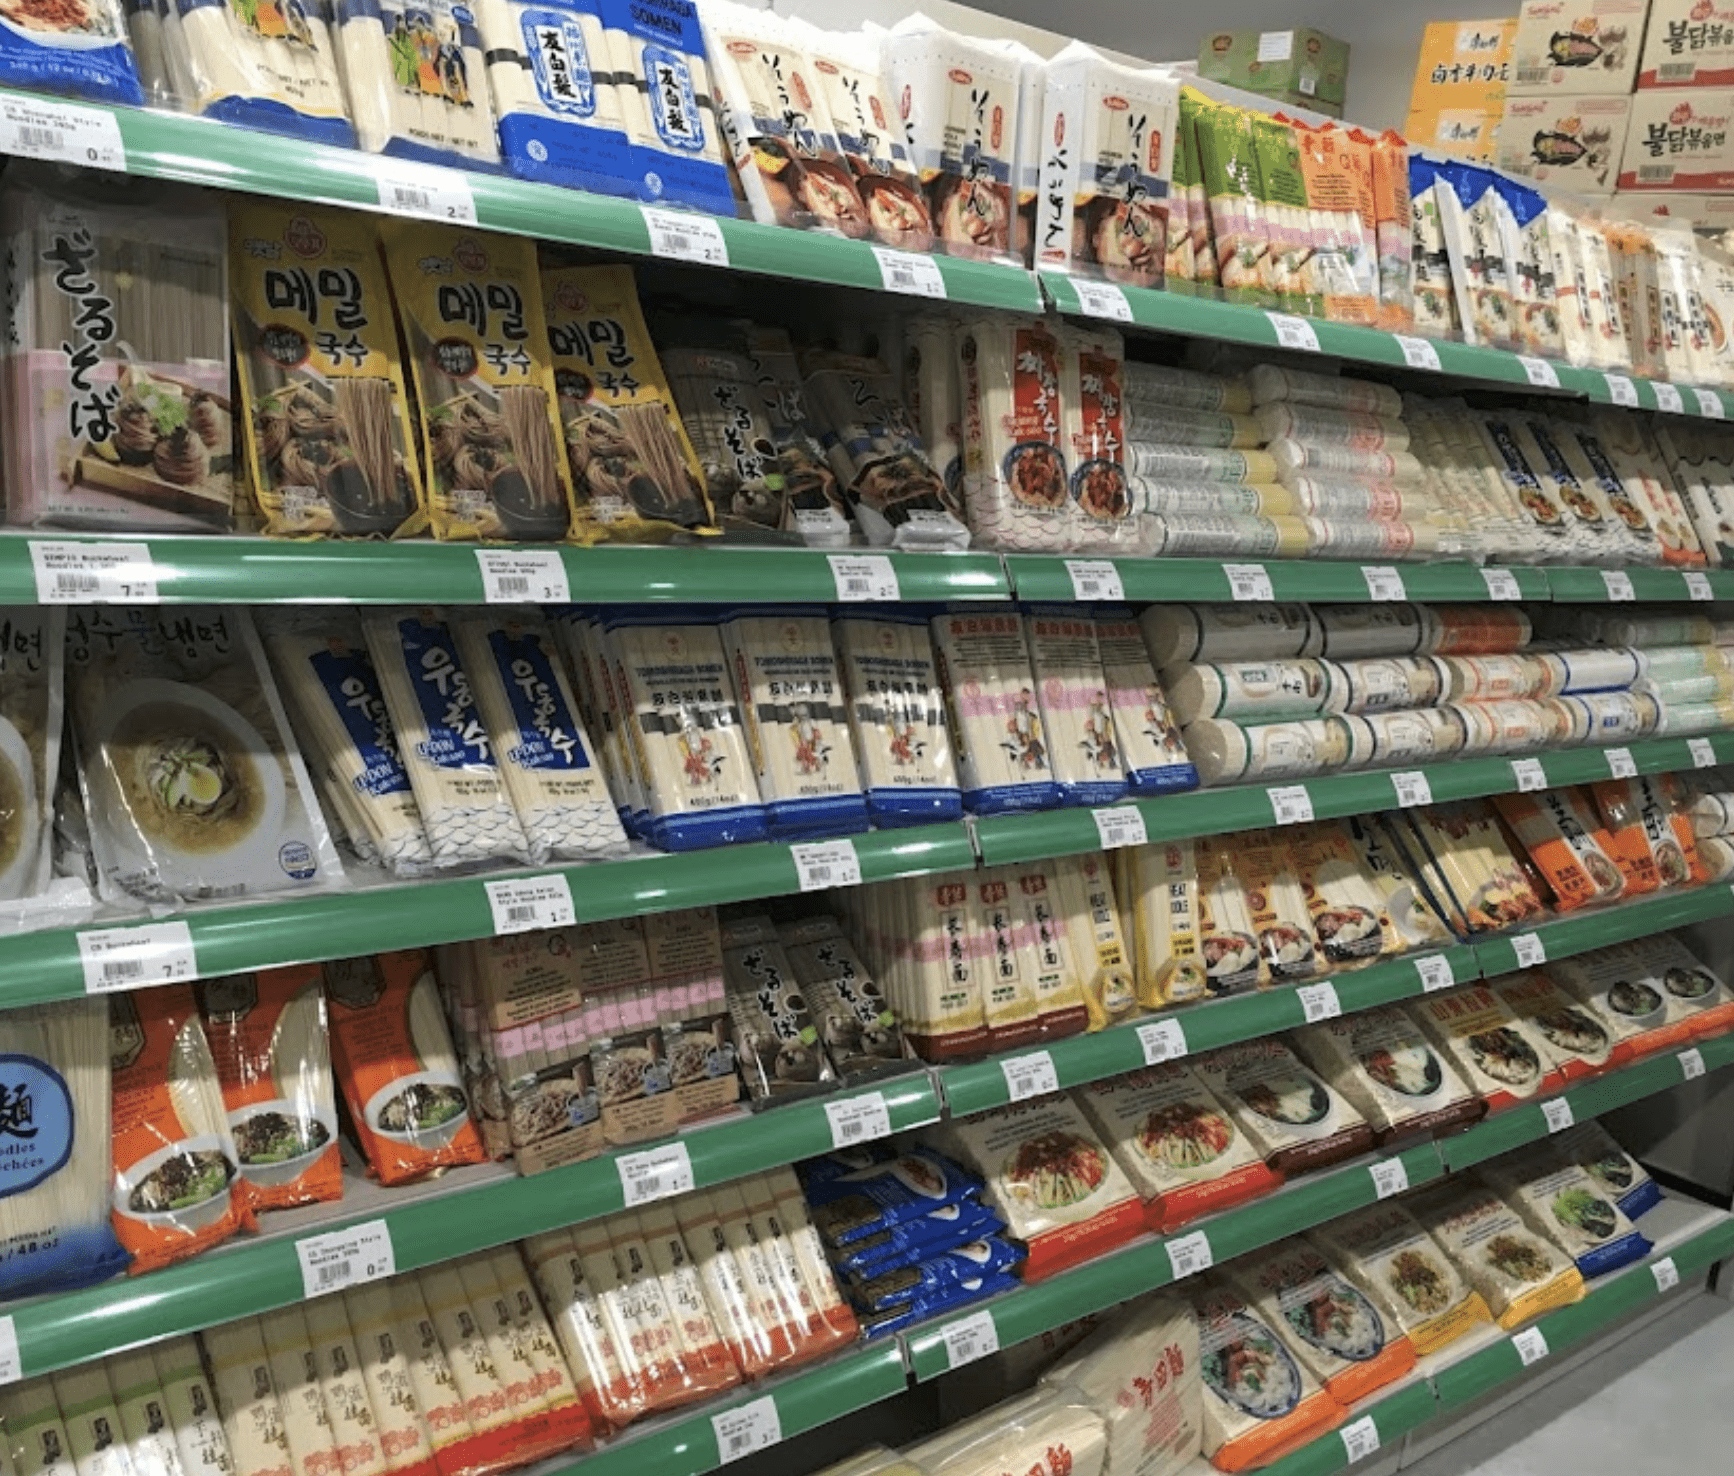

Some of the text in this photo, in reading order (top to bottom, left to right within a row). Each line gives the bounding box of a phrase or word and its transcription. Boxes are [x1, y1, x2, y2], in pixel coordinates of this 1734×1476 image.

[630, 3, 683, 35] SOMEN
[1642, 123, 1726, 157] 불닭볶음면
[265, 267, 368, 330] 메밀
[439, 282, 529, 340] 메밀
[42, 229, 120, 442] ざるそば
[315, 332, 369, 368] 국수
[548, 318, 635, 367] 메밀
[484, 344, 531, 376] 국수
[596, 371, 640, 398] 국수
[120, 585, 131, 597] 7
[422, 646, 490, 760] 우동국수
[512, 659, 575, 763] 우동국수
[342, 677, 403, 769] 우동국
[18, 1242, 36, 1255] 48
[42, 1237, 58, 1250] oz
[367, 1264, 374, 1275] 0
